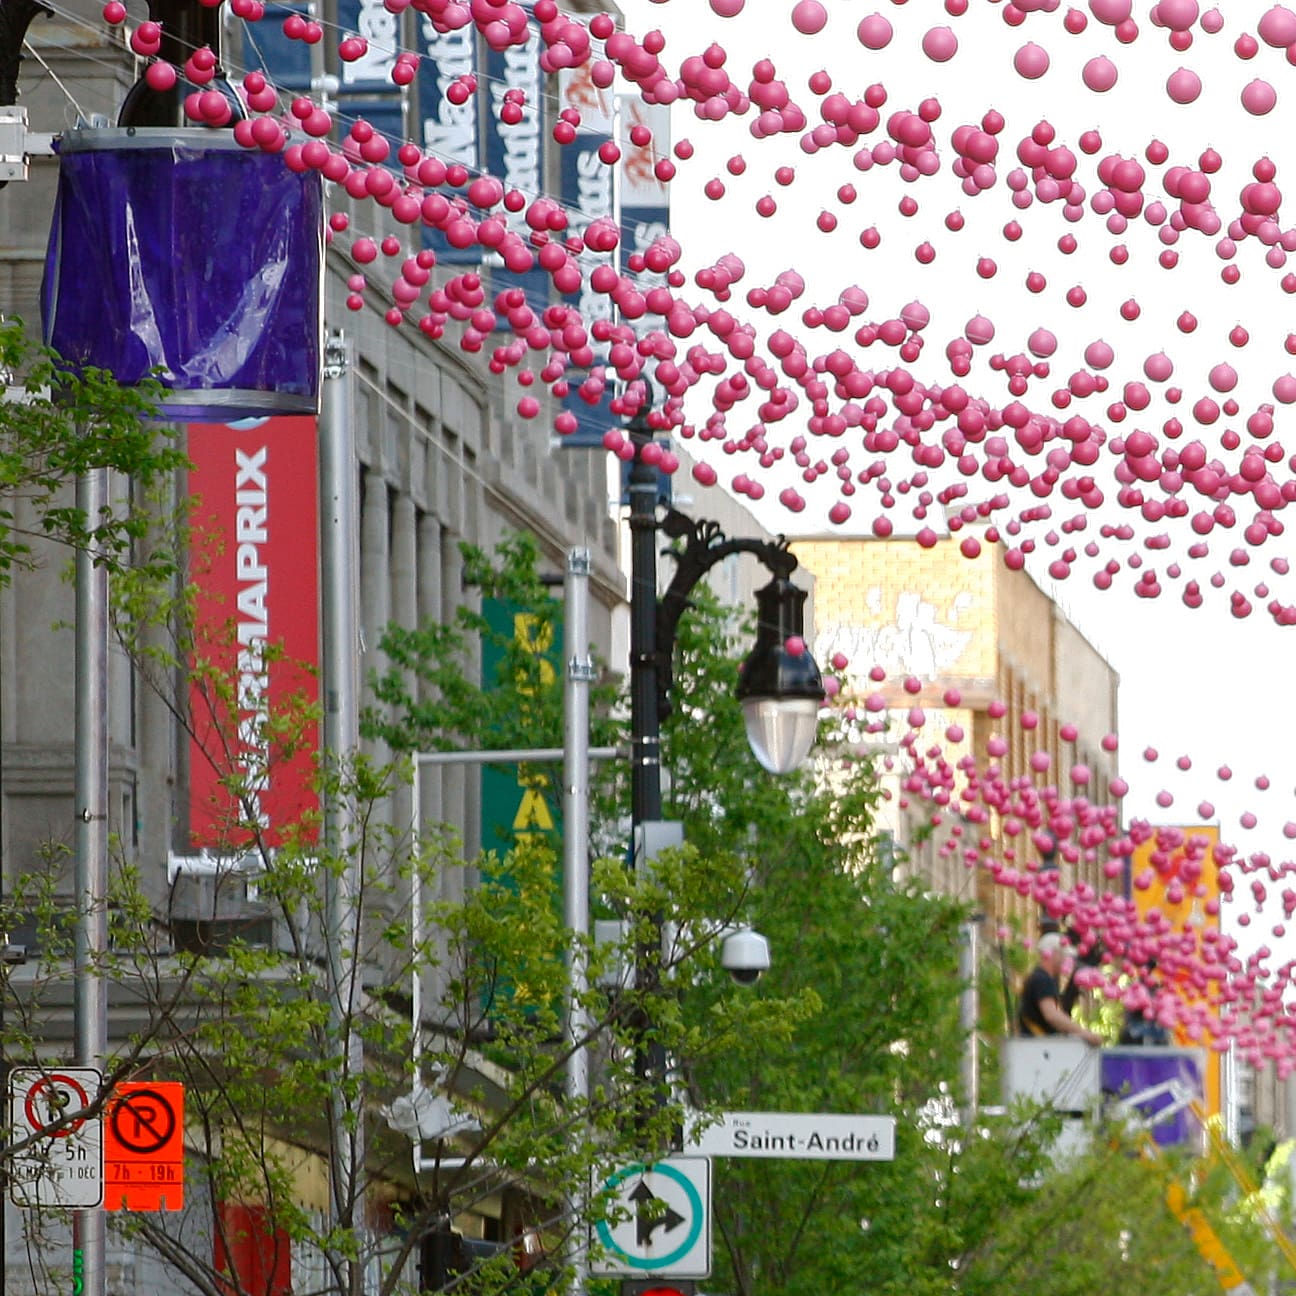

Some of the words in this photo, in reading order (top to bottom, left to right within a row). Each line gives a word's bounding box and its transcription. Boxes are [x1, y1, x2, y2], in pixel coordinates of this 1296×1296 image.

[733, 1129, 879, 1153] Saint-André
[66, 1144, 86, 1161] 5h
[113, 1164, 130, 1180] 7h
[150, 1164, 175, 1181] 19h
